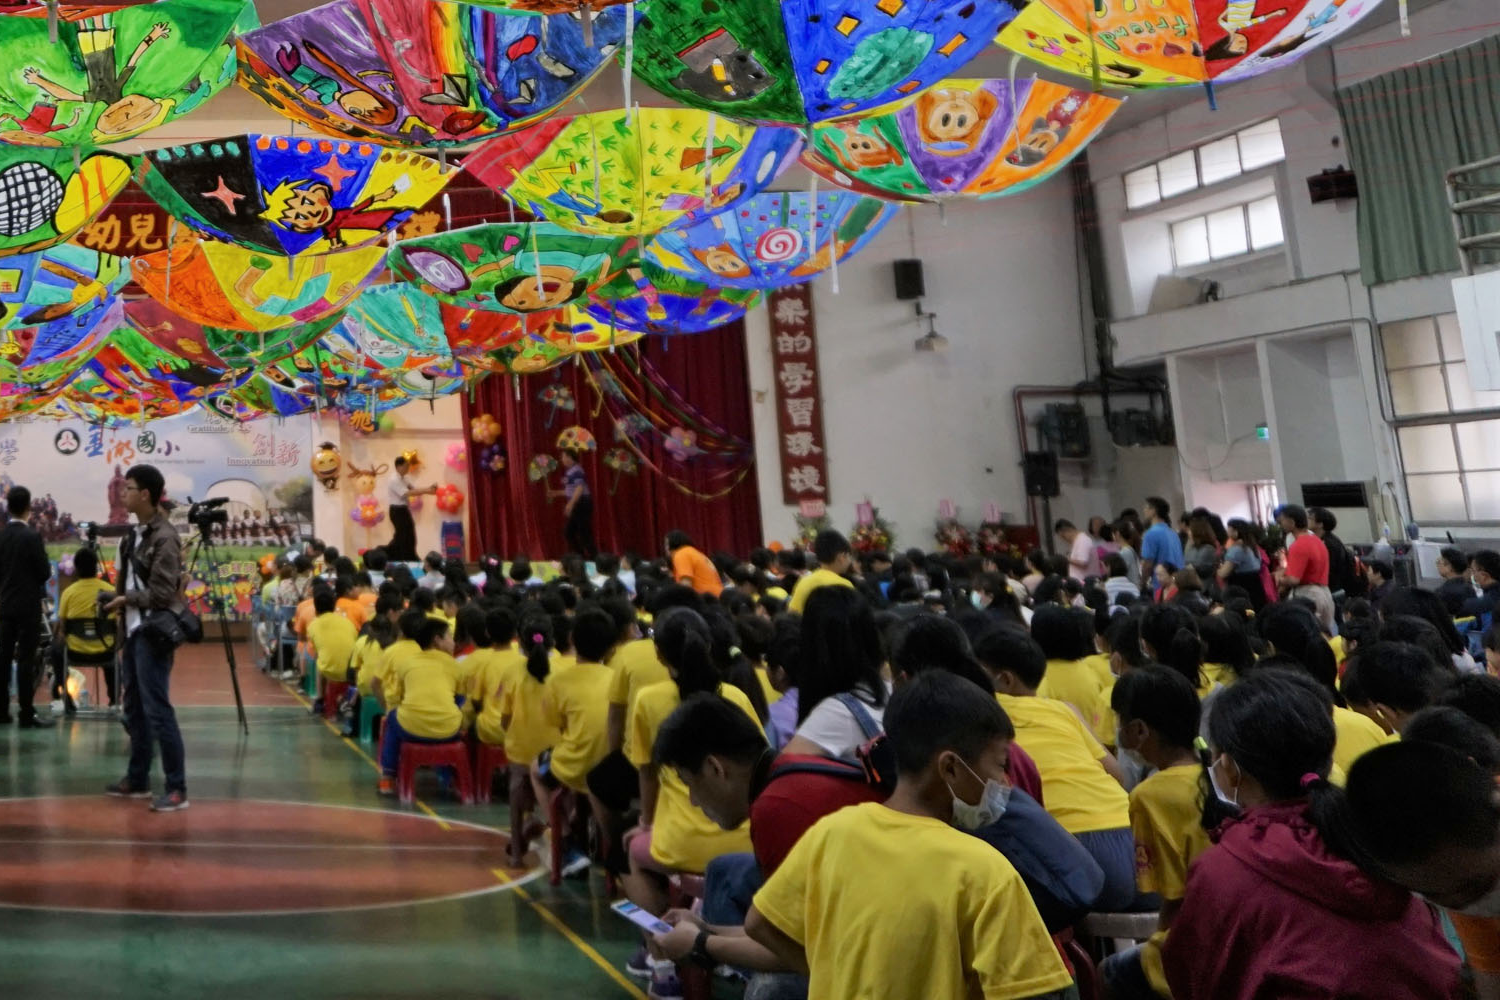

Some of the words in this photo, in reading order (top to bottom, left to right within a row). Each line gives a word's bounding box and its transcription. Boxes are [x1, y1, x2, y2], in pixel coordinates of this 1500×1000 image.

[774, 283, 826, 493] 樂的學習環境
[227, 457, 277, 467] Innovation
